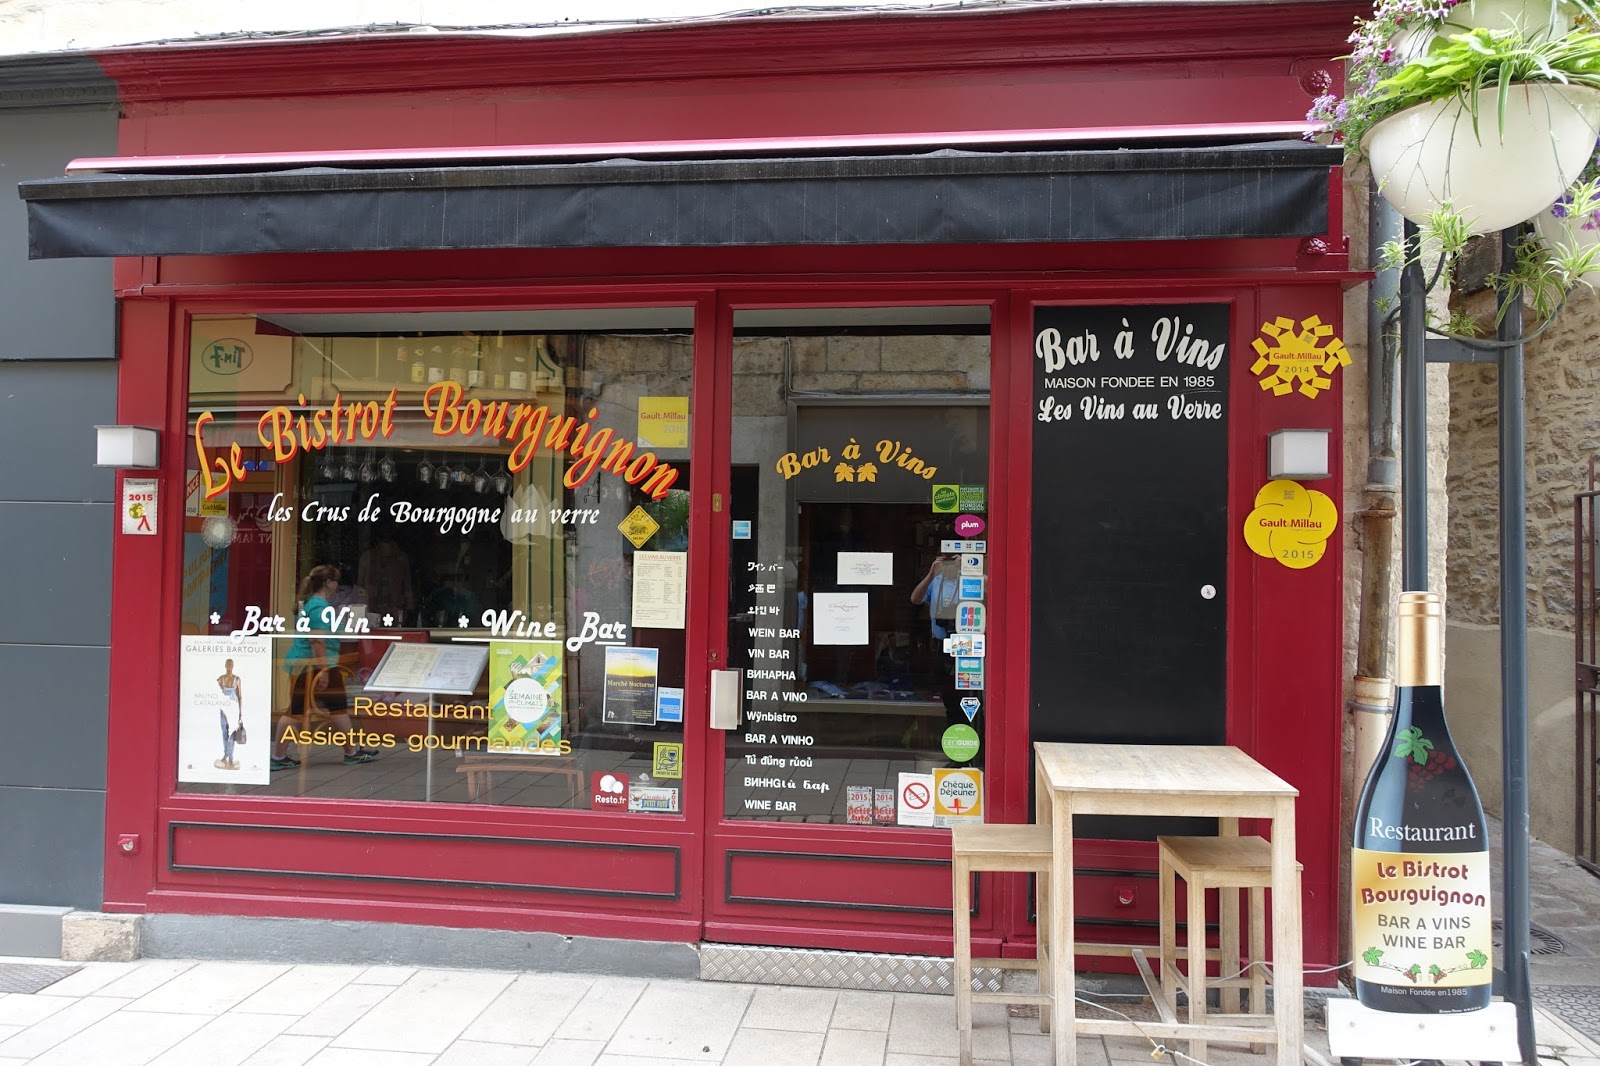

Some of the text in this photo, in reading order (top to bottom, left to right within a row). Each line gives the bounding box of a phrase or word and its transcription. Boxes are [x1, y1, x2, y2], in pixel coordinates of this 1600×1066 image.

[1035, 316, 1226, 374] Bar à Vins
[1044, 376, 1214, 388] MAISON FONDEE EN 1985
[1038, 394, 1222, 422] Les Vins au Verre
[195, 380, 680, 500] Le Bistrot Bourguignon
[776, 438, 938, 480] Bar à Vins
[266, 493, 600, 534] les Crus de Bourgogne au verre
[961, 521, 979, 530] plum
[1283, 550, 1314, 559] 2015
[230, 606, 370, 644] Bar à Vin
[481, 608, 556, 638] Wine
[566, 611, 626, 652] Bar
[748, 628, 800, 638] WEIN BAR
[748, 649, 790, 659] VIN BAR
[746, 691, 808, 702] BAR A VINO
[354, 697, 494, 720] Restaurant
[280, 726, 572, 755] Assiettes gourmandes
[745, 734, 814, 746] BAR A VINHO
[595, 794, 627, 804] Resto.fr
[940, 788, 977, 798] Déjeuner
[745, 800, 797, 811] WINE BAR
[1370, 816, 1476, 842] Restaurant
[1377, 860, 1469, 880] Le Bistrot
[1361, 886, 1485, 907] Bourguignon
[1378, 914, 1471, 930] BAR A VINS
[1382, 933, 1466, 950] WINE BAR
[1381, 986, 1407, 995] Maison
[1409, 988, 1436, 996] Fondée
